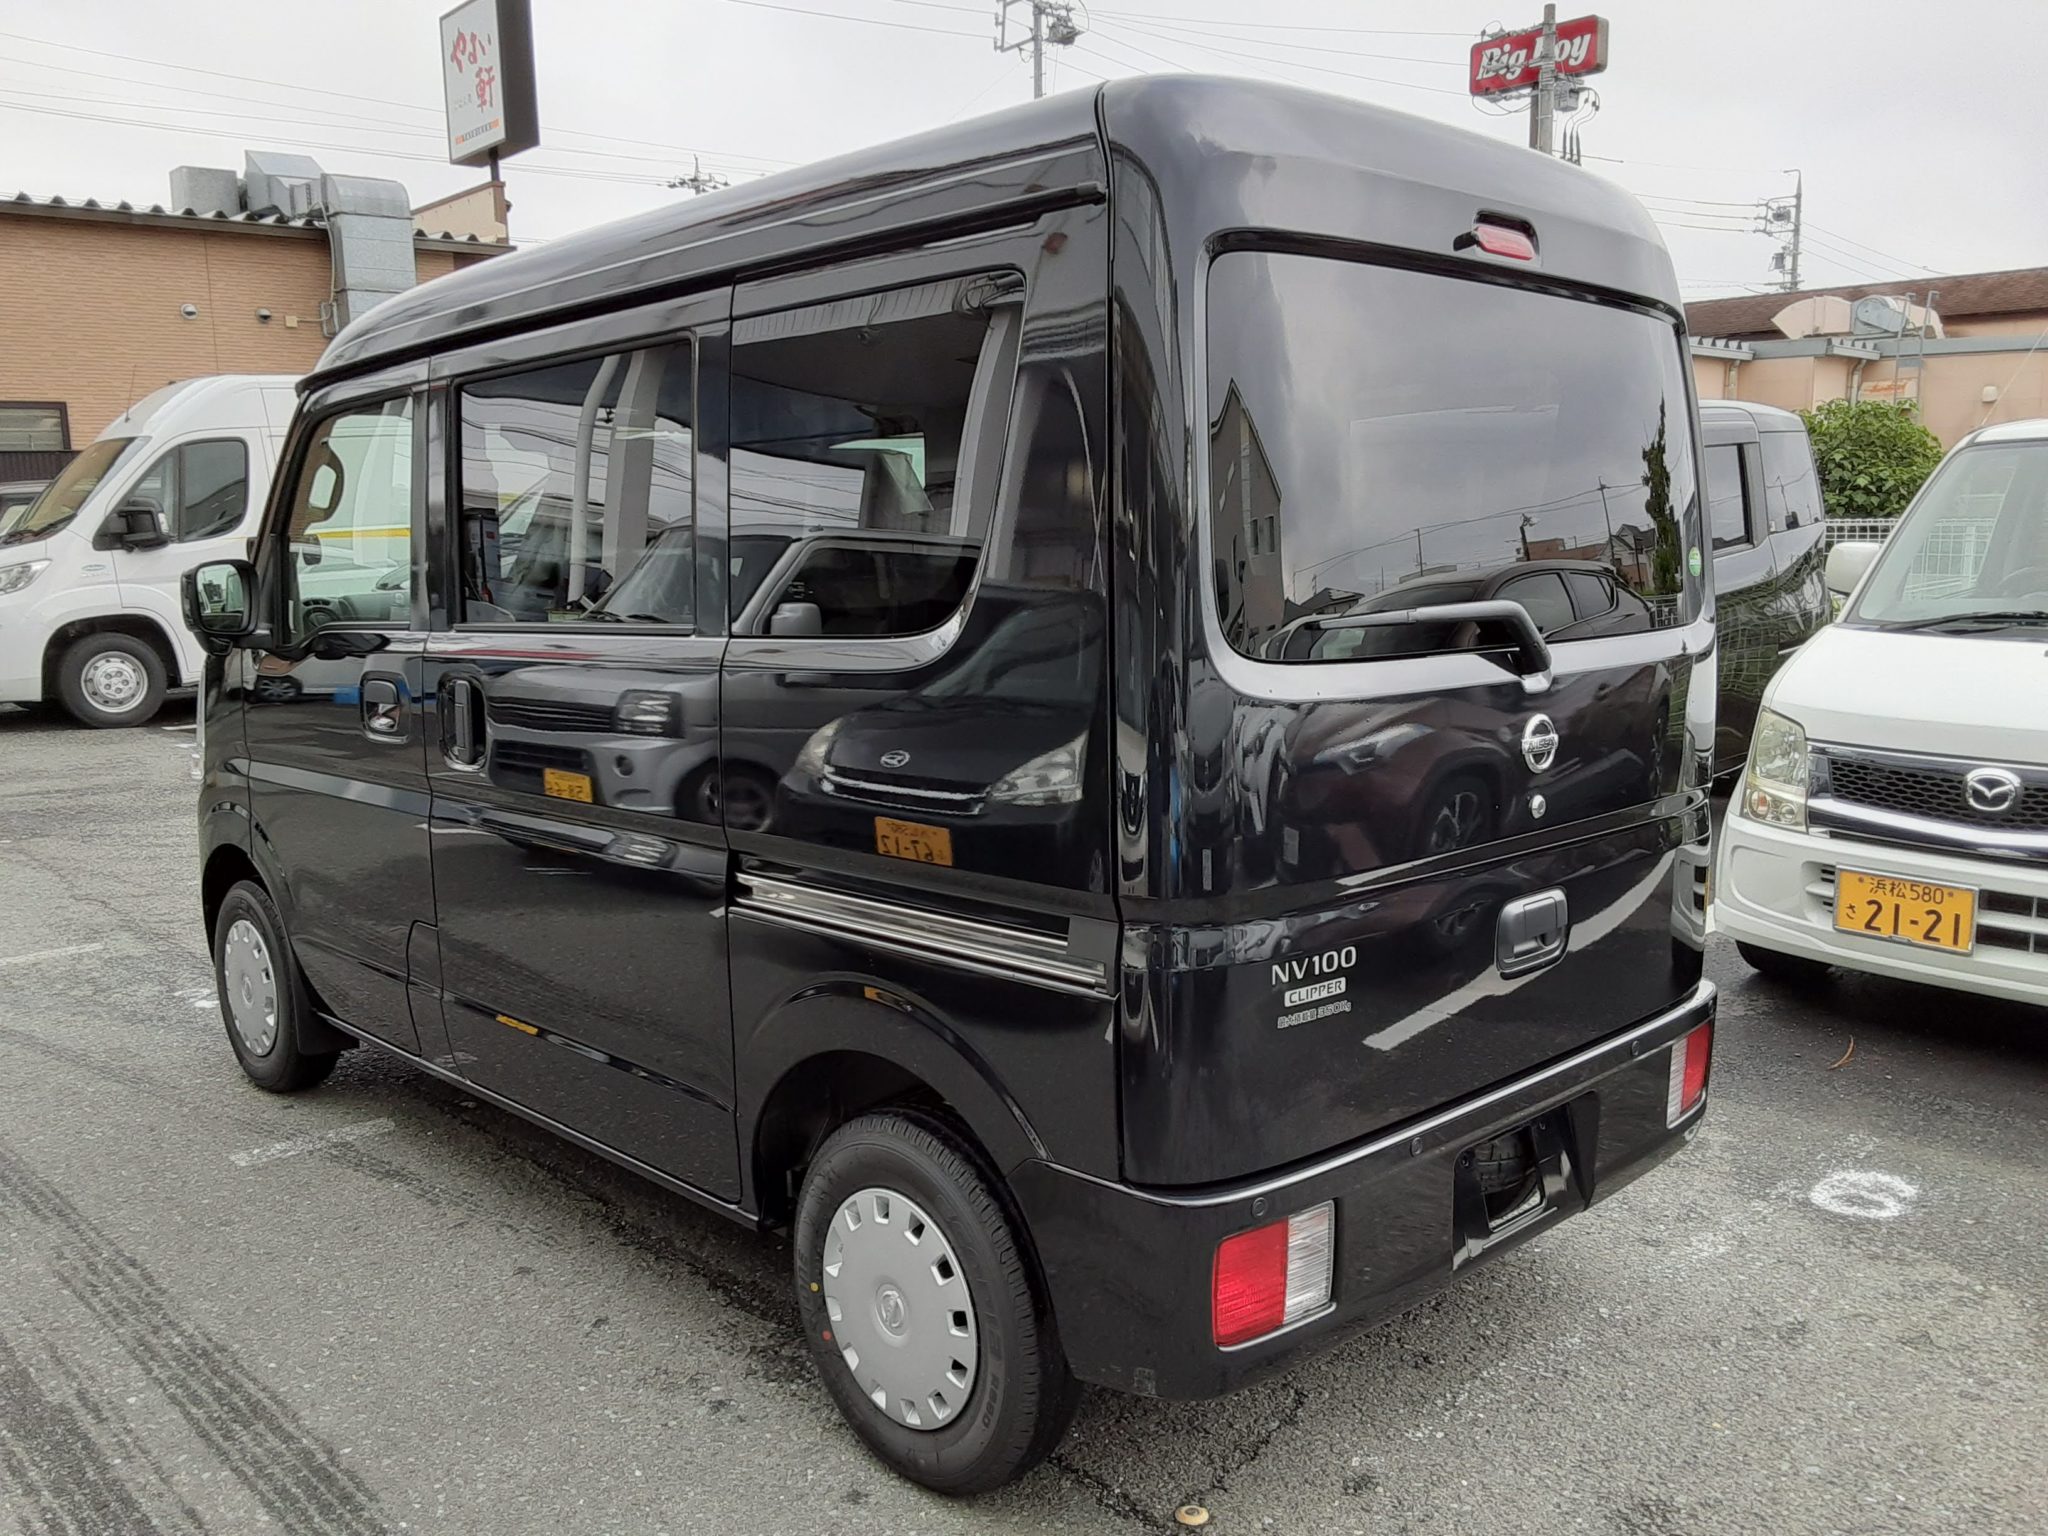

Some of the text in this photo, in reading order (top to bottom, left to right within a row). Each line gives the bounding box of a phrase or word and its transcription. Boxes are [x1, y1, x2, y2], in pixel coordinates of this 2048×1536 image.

[1476, 44, 1528, 80] Big
[1845, 900, 1961, 946] さ 21-21
[1272, 946, 1357, 985] NV100
[1289, 981, 1342, 1003] CLIPPER
